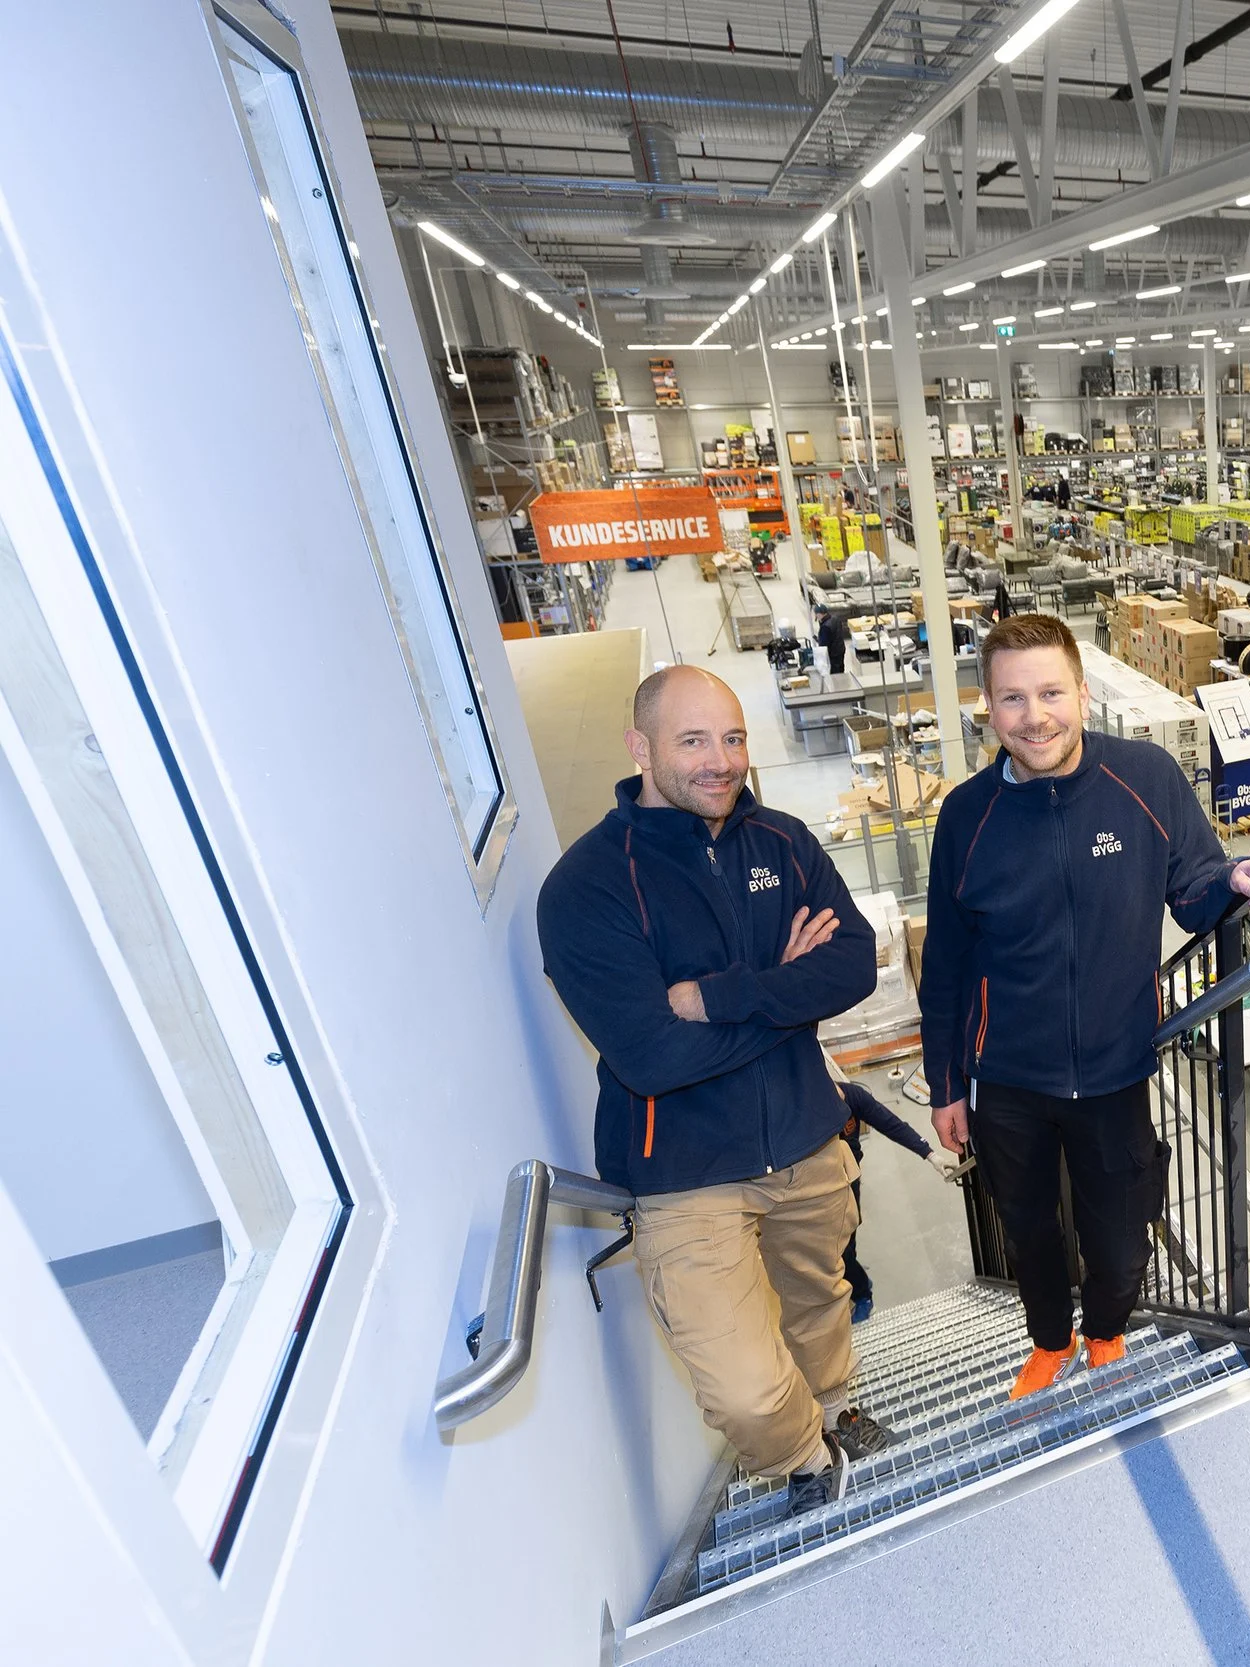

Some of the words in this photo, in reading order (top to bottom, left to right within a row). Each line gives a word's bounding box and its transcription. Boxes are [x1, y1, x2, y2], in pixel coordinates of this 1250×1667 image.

[548, 516, 711, 548] KUNDESERVICE
[1096, 832, 1115, 843] Obs
[1092, 841, 1122, 857] BYGG
[750, 867, 771, 878] Obs
[749, 874, 780, 893] BYGG
